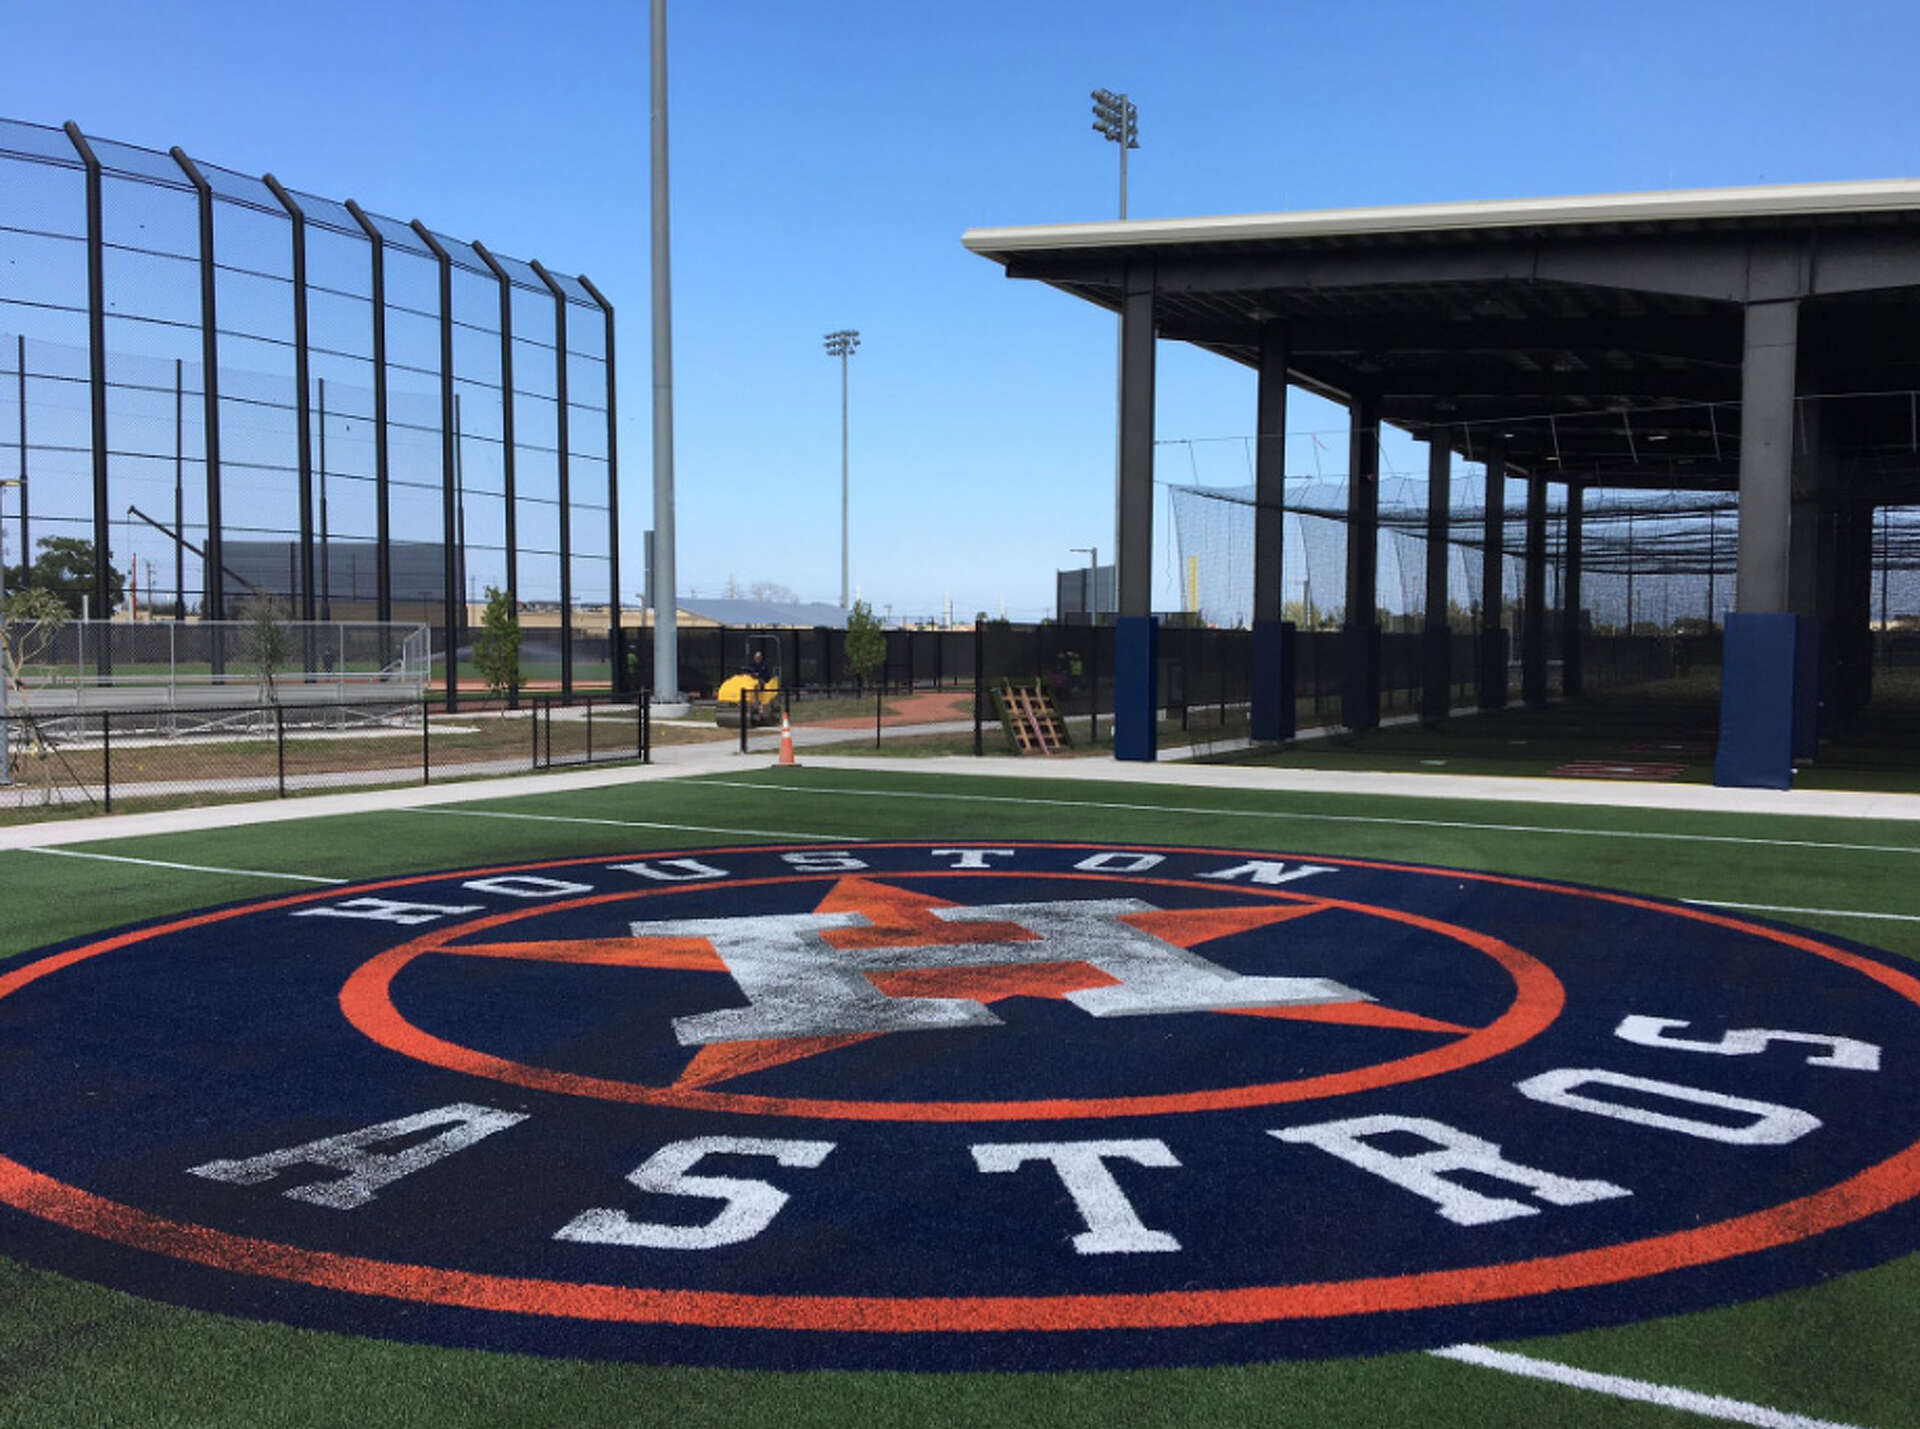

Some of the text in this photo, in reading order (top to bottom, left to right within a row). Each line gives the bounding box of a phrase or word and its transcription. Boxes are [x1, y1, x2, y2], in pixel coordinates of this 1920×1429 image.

[291, 847, 1337, 925] HOUSTON
[629, 897, 1379, 1046] H
[187, 1015, 1881, 1255] ASTROS
